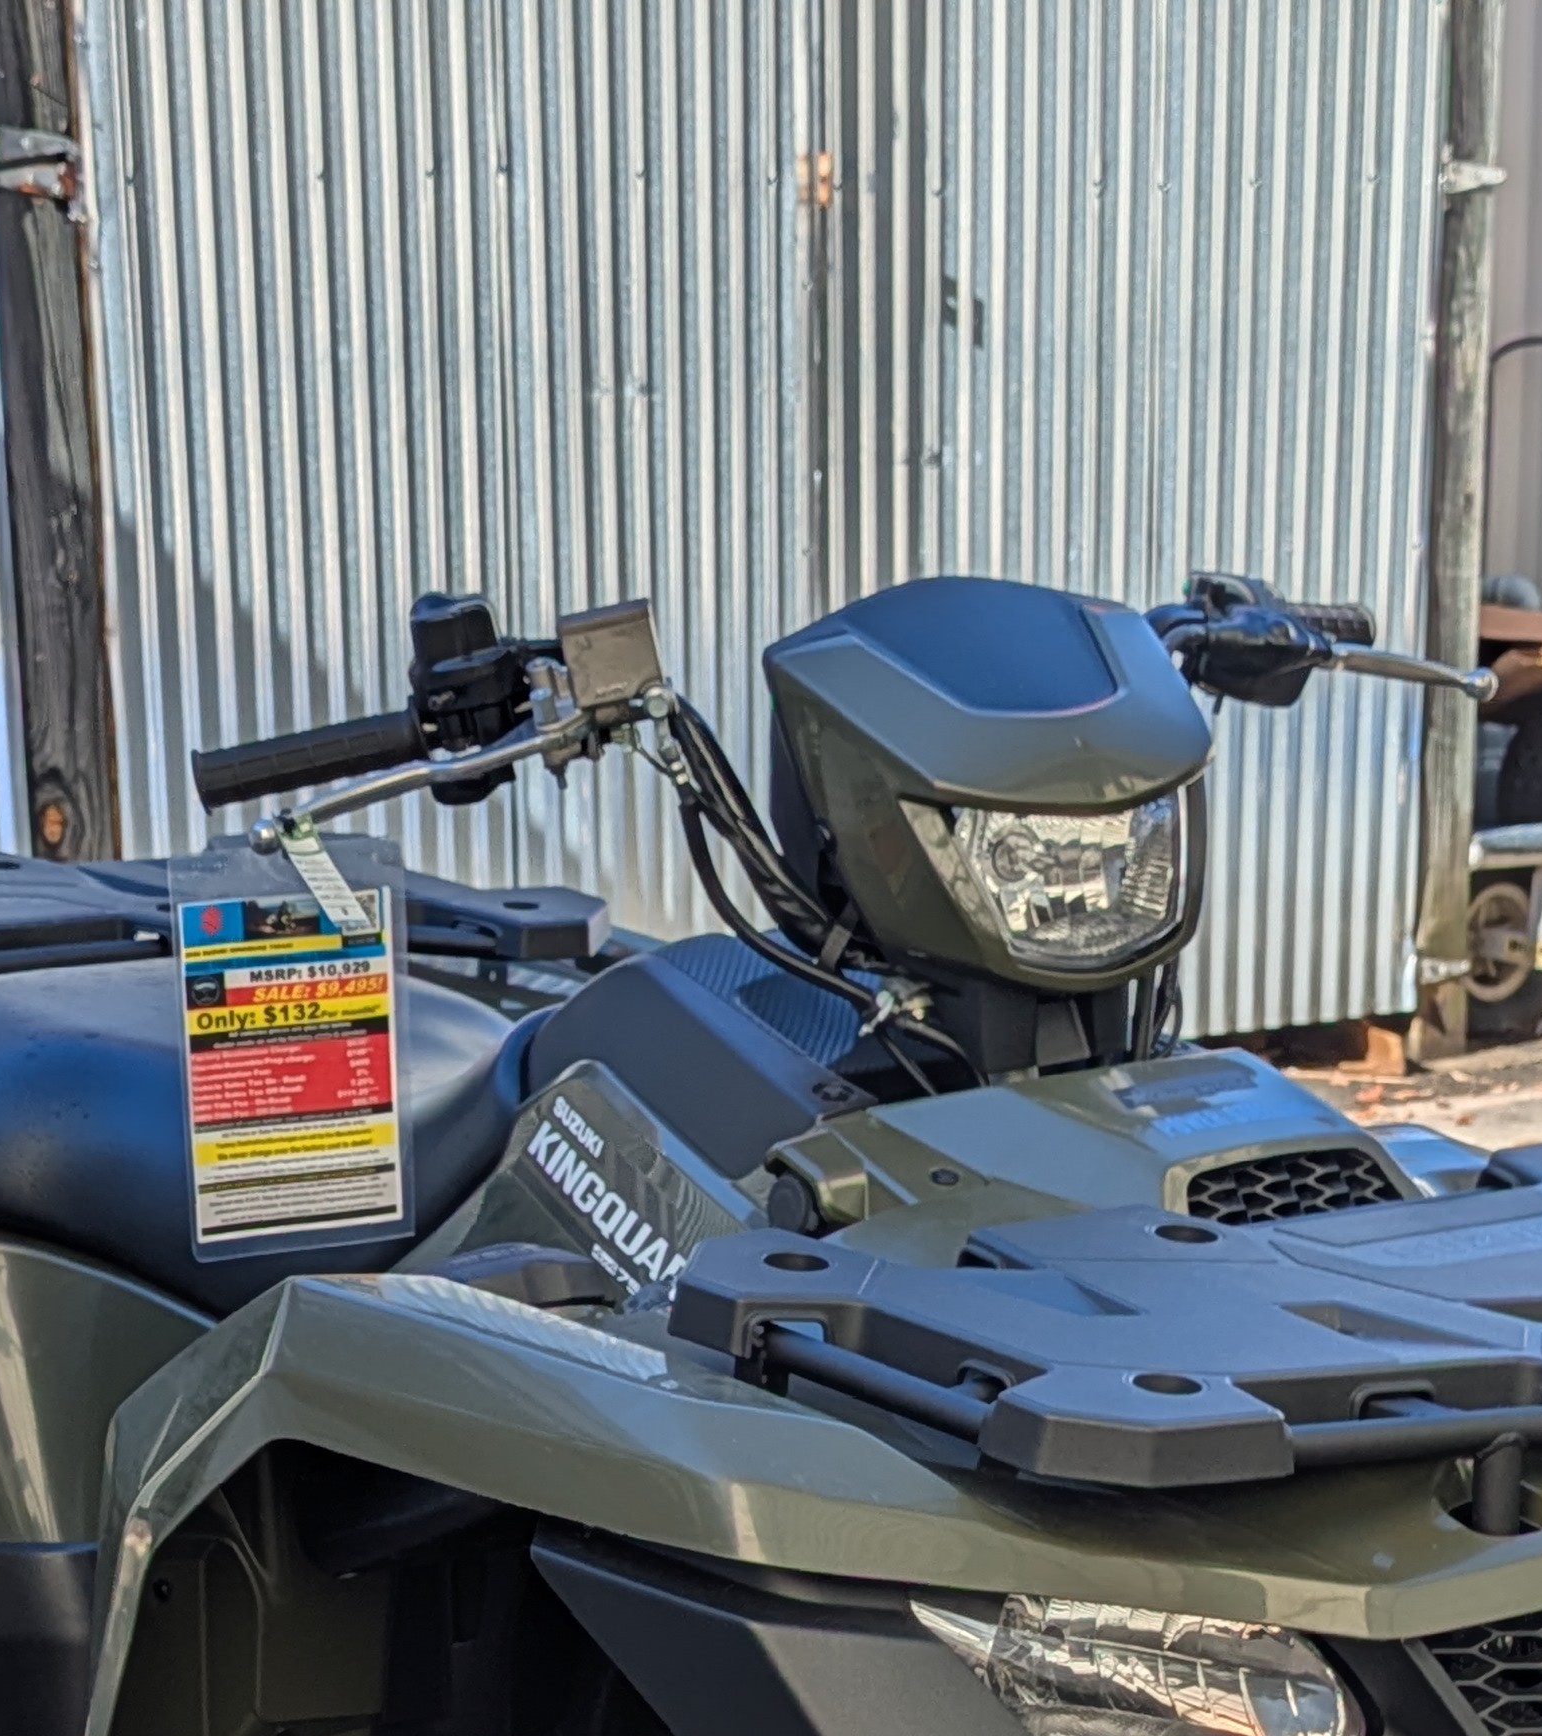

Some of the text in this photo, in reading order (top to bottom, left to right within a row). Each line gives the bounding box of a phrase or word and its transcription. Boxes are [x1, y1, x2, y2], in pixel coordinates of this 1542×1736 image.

[250, 960, 371, 983] MSRP: $10,929
[252, 976, 385, 1003] SALE: $9,495!
[196, 1007, 256, 1031] Only:
[264, 1002, 320, 1024] $132
[552, 1095, 605, 1159] SUZUKI
